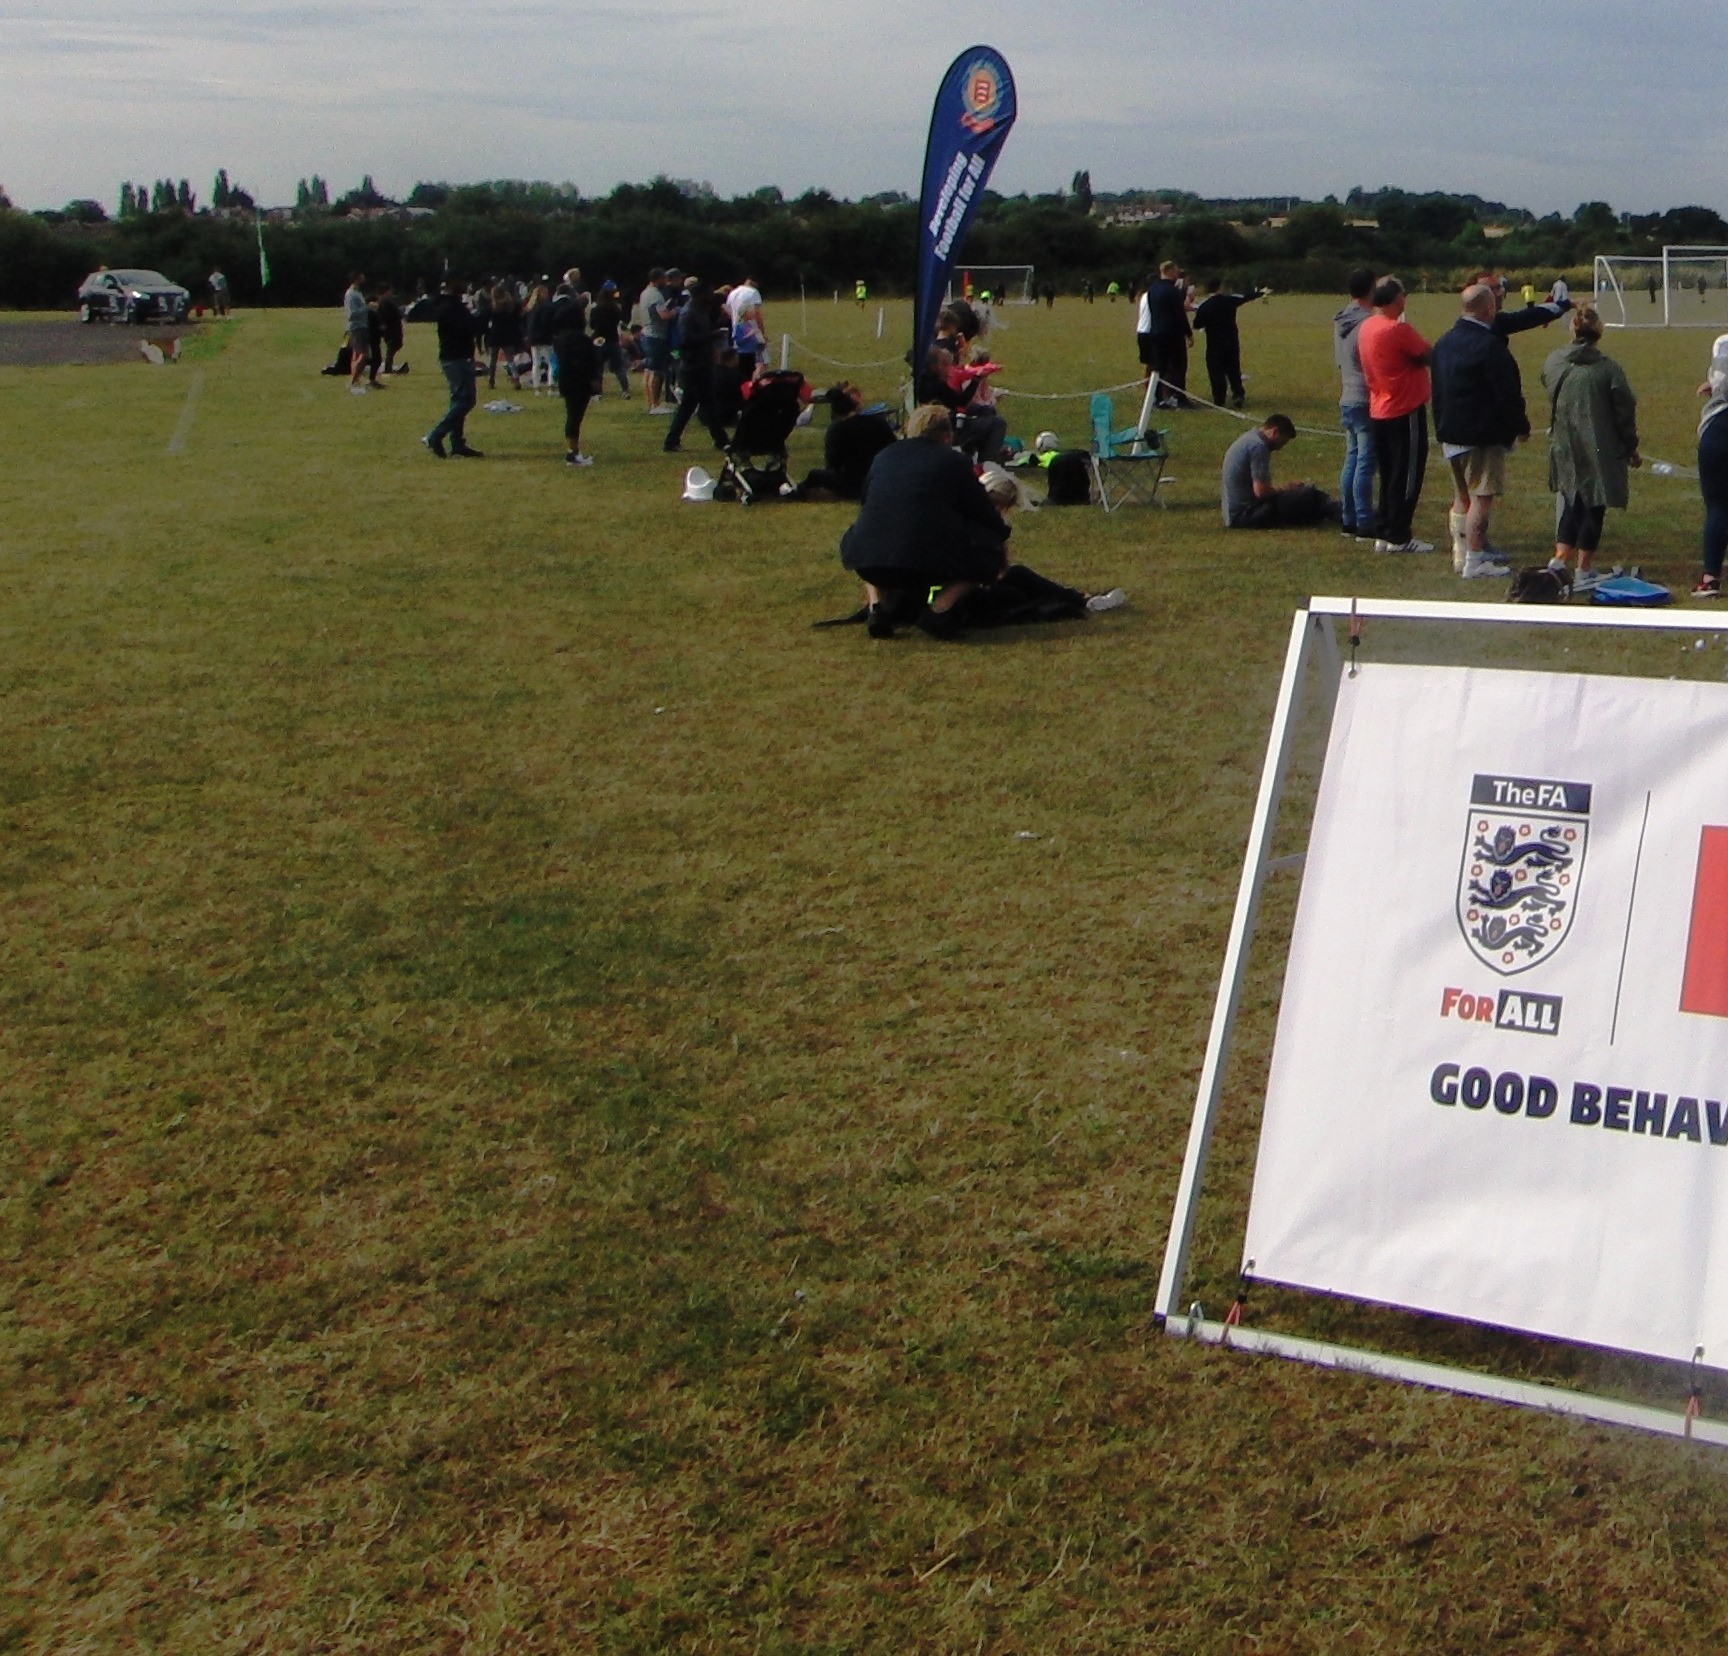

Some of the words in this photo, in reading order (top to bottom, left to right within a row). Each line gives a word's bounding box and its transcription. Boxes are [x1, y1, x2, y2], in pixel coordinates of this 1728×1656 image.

[934, 196, 968, 261] Football
[958, 174, 976, 202] for
[969, 152, 985, 180] All
[1441, 988, 1492, 1025] FOR
[1500, 995, 1557, 1032] ALL
[1429, 1062, 1559, 1120] GOOD
